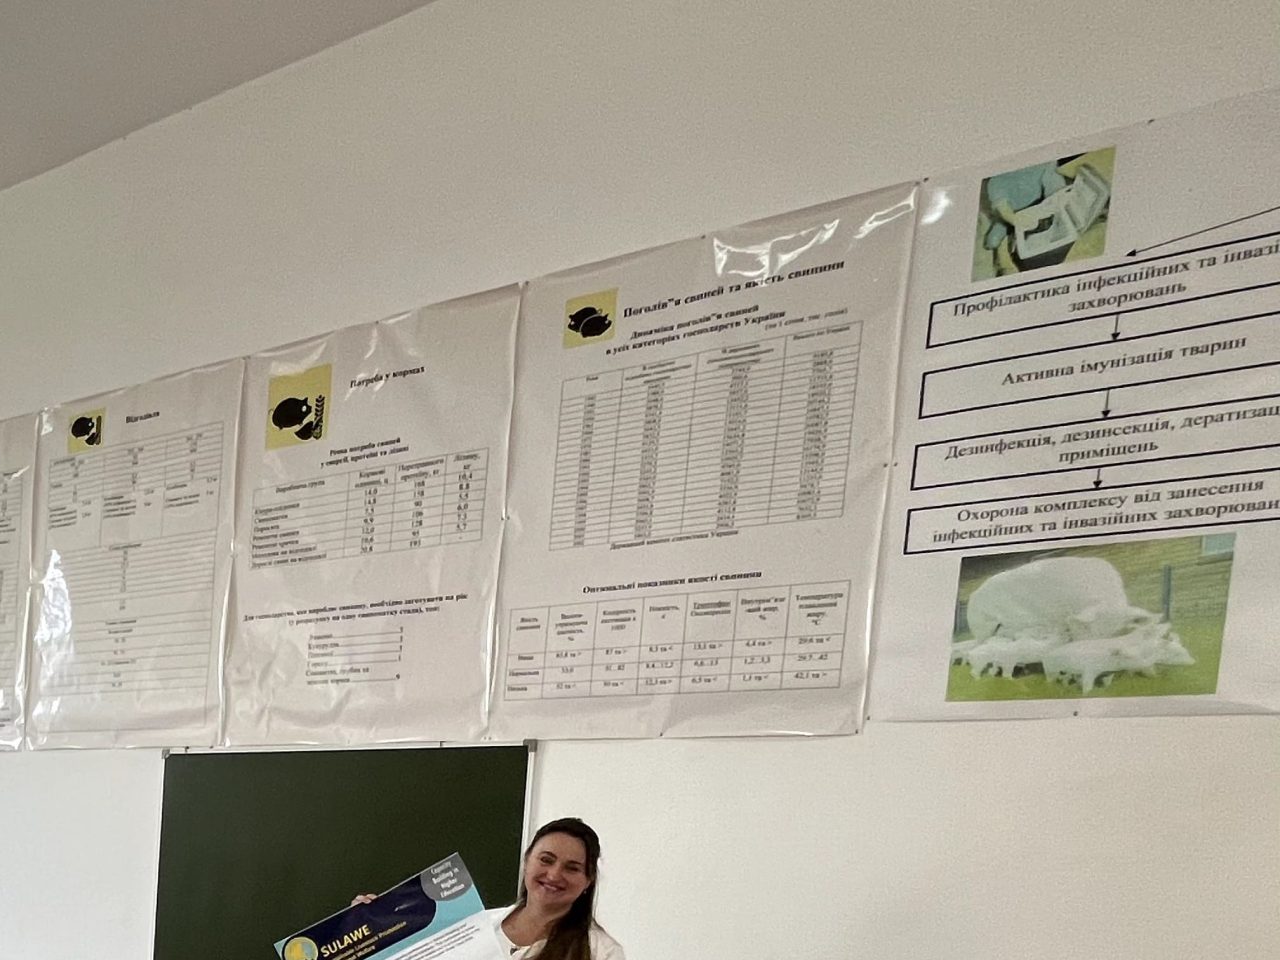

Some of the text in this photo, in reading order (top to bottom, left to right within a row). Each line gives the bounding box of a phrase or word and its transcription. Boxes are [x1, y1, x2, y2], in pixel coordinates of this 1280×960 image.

[684, 285, 724, 305] свиней
[729, 283, 741, 293] та
[953, 284, 1070, 317] Профілактика
[1076, 262, 1191, 293] інфекційних
[1197, 256, 1217, 270] та
[1069, 281, 1187, 314] захворювань
[1001, 336, 1247, 386] Активна імунізація тварин
[944, 434, 1056, 461] Дезинфекція,
[1061, 418, 1176, 445] дезинсекція,
[1058, 440, 1159, 465] приміщень
[956, 479, 1265, 524] Охорона комплексу від занесення
[932, 520, 1034, 545] інфекційних
[1040, 518, 1058, 533] та
[1062, 510, 1158, 531] інвазійних
[320, 924, 371, 958] SULAWE
